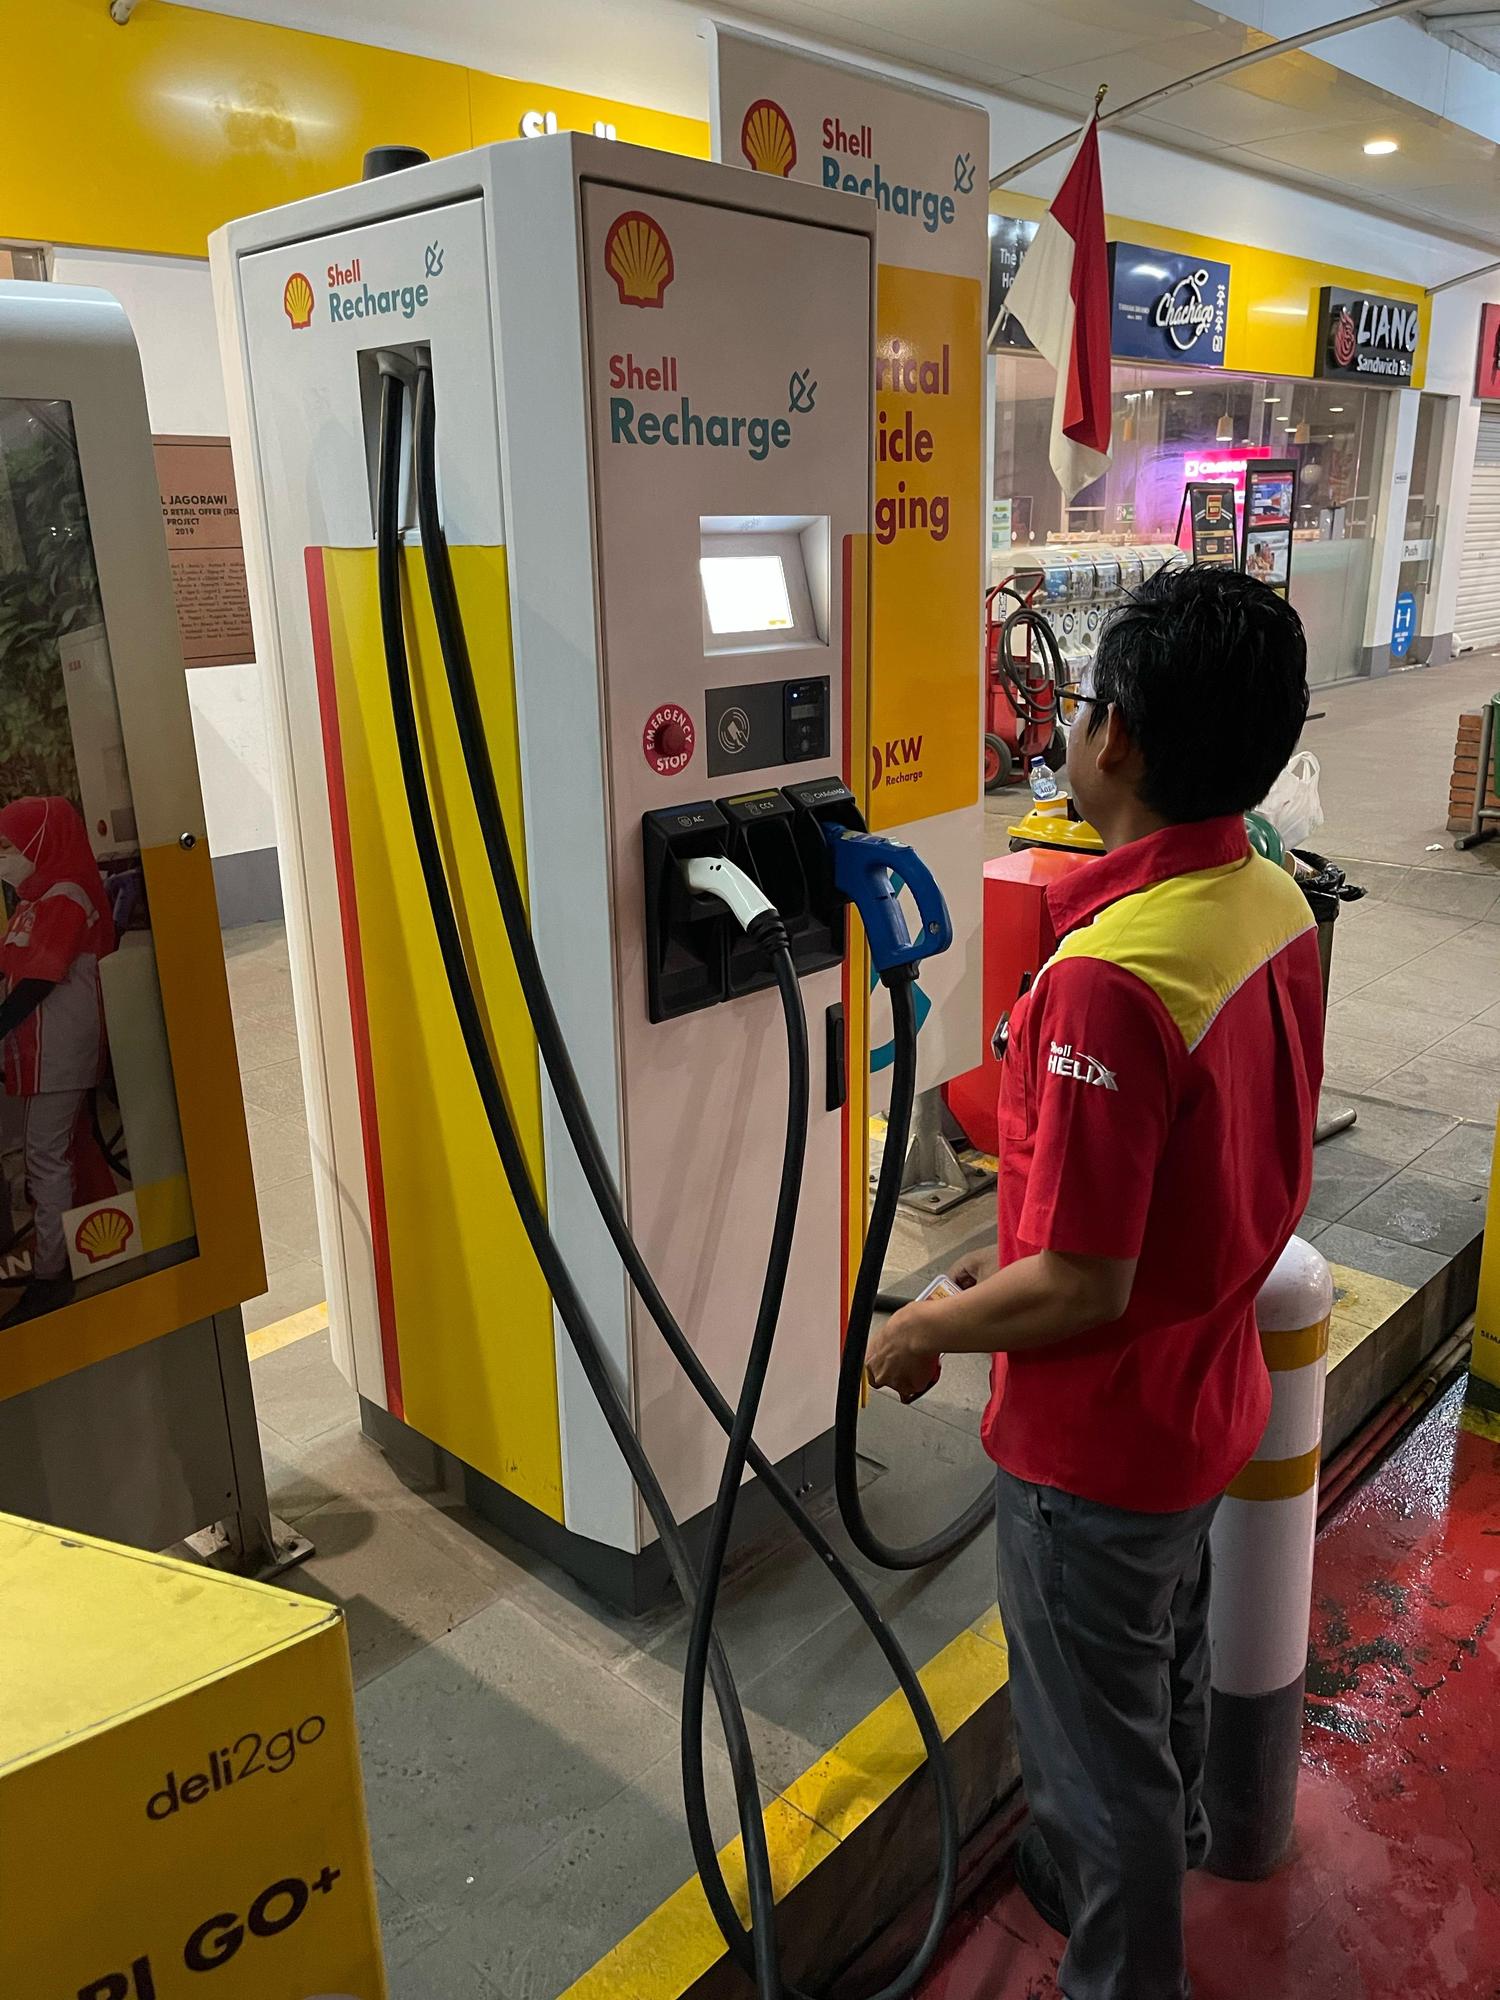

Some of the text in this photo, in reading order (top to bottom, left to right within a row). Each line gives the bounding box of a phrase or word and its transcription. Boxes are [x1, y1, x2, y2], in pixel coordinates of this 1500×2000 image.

[822, 117, 872, 159] Shell
[822, 155, 955, 233] Recharge
[327, 258, 361, 288] Shell
[1000, 248, 1018, 266] The
[329, 283, 428, 323] Recharge
[1155, 292, 1214, 337] Chachago
[1357, 300, 1419, 352] LIANG
[609, 353, 677, 392] Shell
[1356, 353, 1399, 376] Sandwich
[609, 397, 791, 461] Recharge
[876, 411, 934, 463] icle
[169, 495, 228, 505] JAGORAWI
[170, 508, 196, 516] RETAIL
[198, 508, 222, 516] OFFER
[875, 480, 950, 545] ging
[167, 518, 200, 526] PROJECT
[175, 528, 195, 536] 2019
[646, 708, 692, 751] EMERGENCY
[656, 753, 688, 772] STOP
[885, 771, 923, 787] Recharge
[693, 815, 705, 823] AC
[759, 802, 774, 811] CCS
[1047, 1052, 1119, 1092] HELIX
[146, 1715, 326, 1821] deli2go
[183, 1865, 342, 1973] GO+
